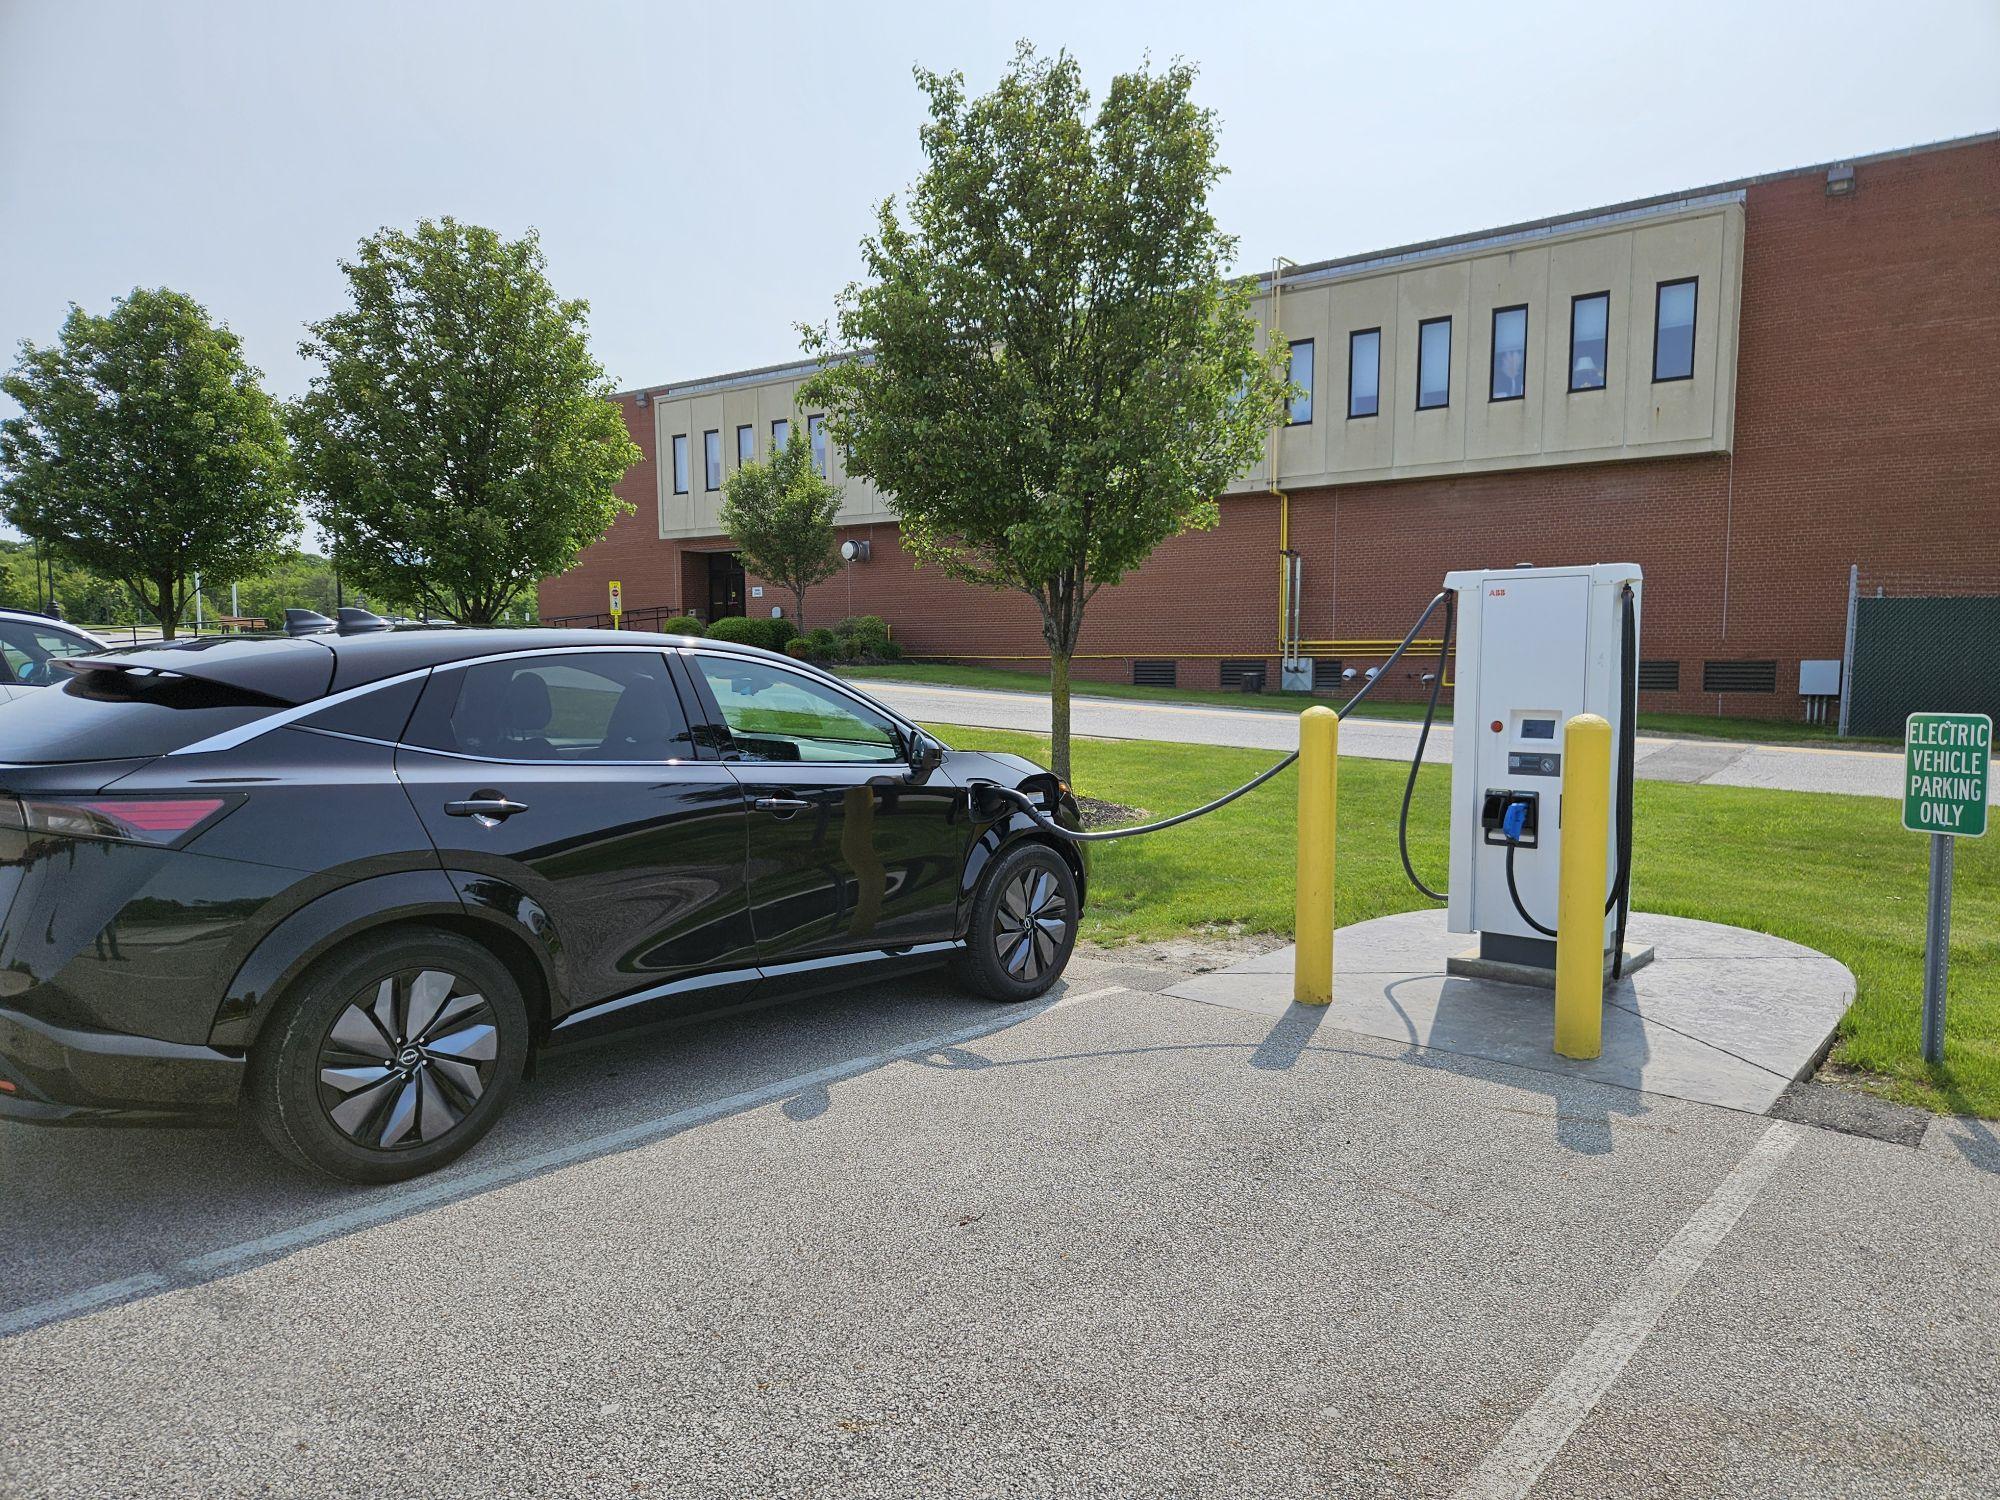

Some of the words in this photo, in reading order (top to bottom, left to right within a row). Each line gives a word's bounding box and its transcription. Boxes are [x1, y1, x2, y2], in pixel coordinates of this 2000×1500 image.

[1488, 589, 1506, 597] ABB
[1909, 722, 1988, 747] ELECTRIC
[1912, 750, 1982, 775] VEHICLE
[1910, 775, 1982, 801] PARKING
[1920, 801, 1964, 827] ONLY
